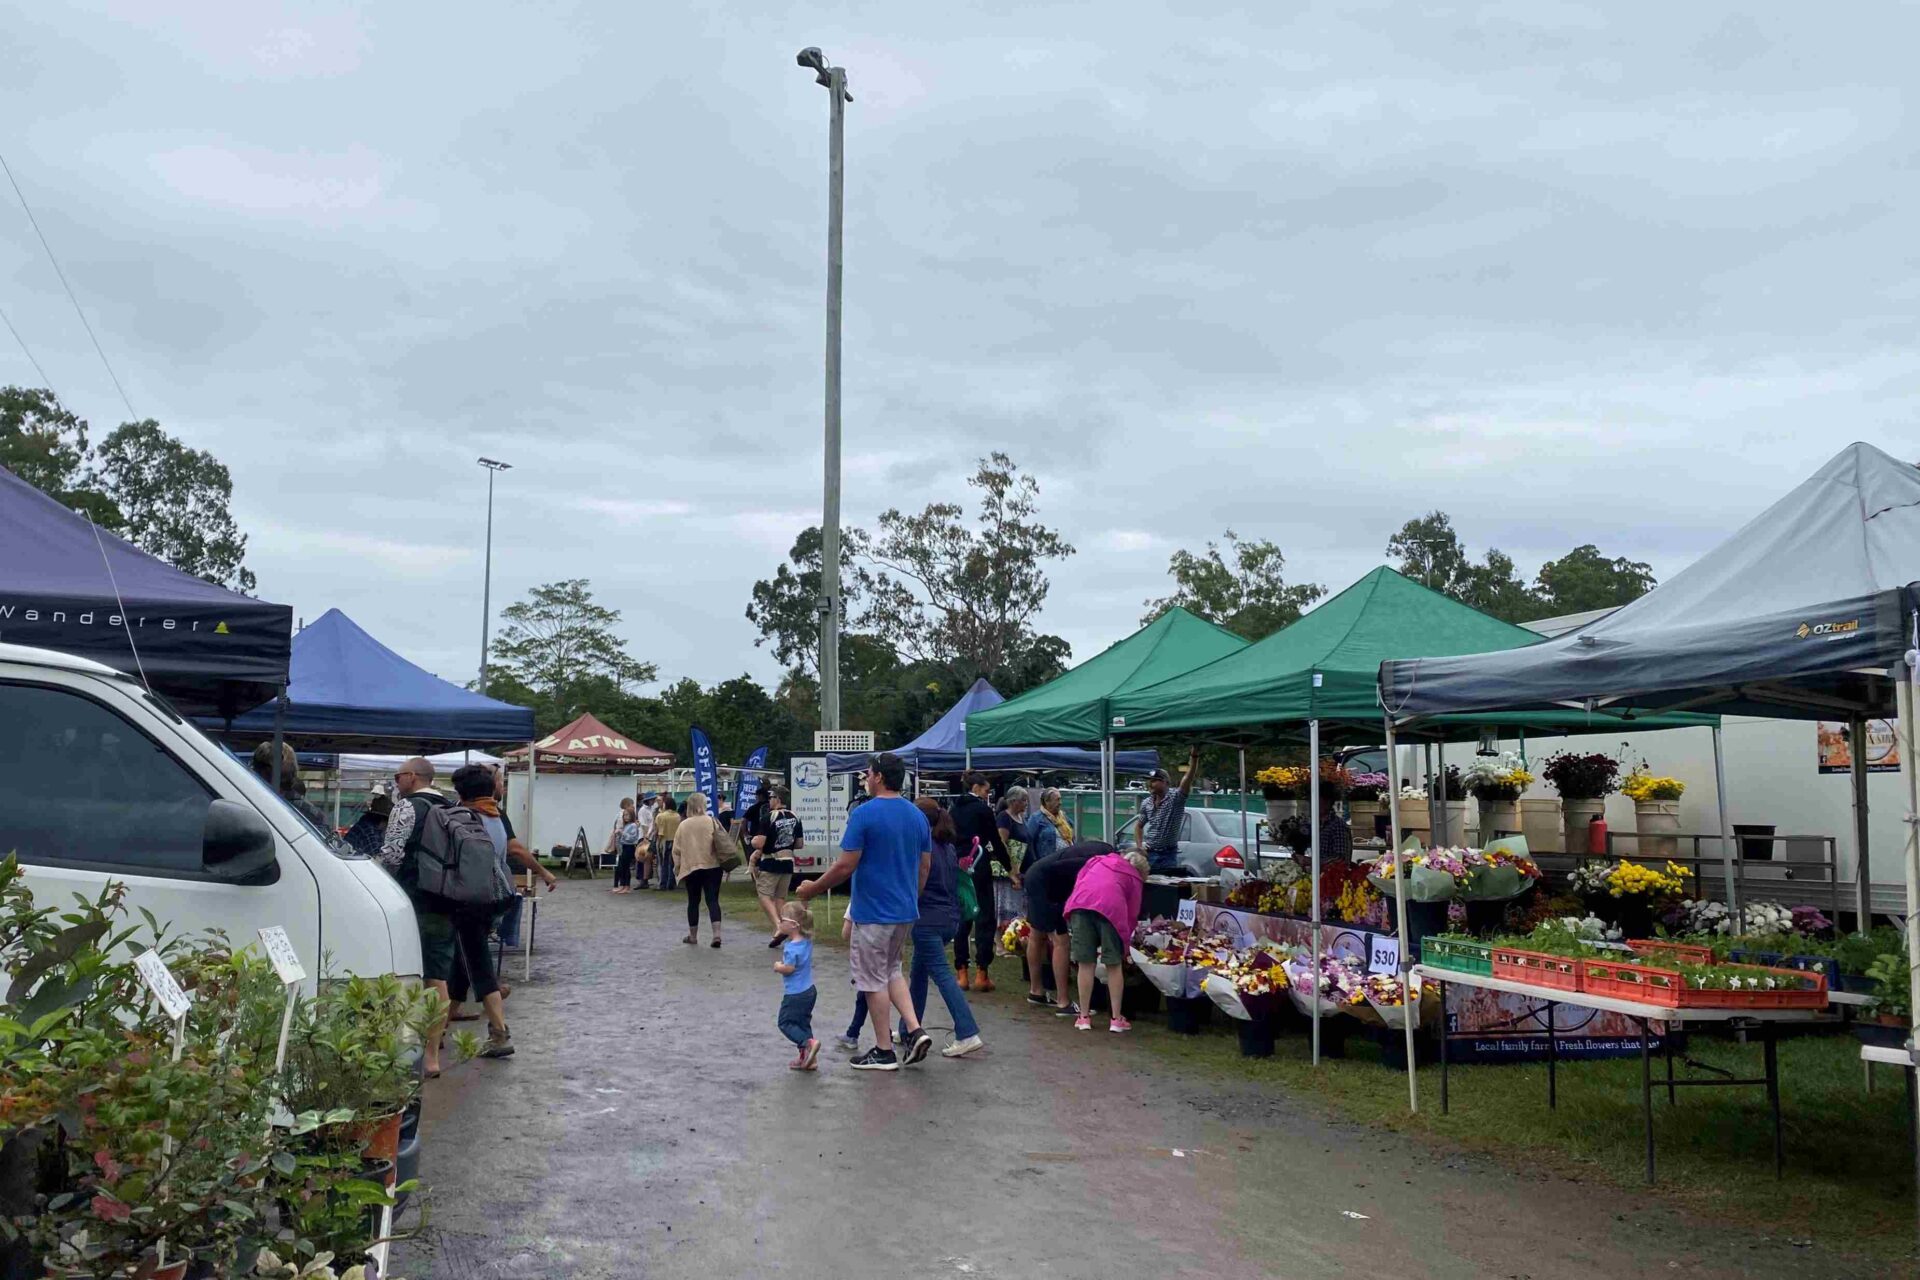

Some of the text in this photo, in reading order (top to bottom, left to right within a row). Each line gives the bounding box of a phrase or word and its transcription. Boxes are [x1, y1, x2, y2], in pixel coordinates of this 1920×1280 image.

[568, 735, 628, 750] ATM
[697, 746, 714, 818] SEAFOO
[1179, 908, 1194, 921] $30
[1374, 950, 1395, 966] $30
[1475, 1041, 1499, 1051] Local
[1501, 1040, 1529, 1052] family
[1560, 1040, 1584, 1050] Fresh
[1586, 1040, 1620, 1050] flowers
[1621, 1039, 1641, 1049] that
